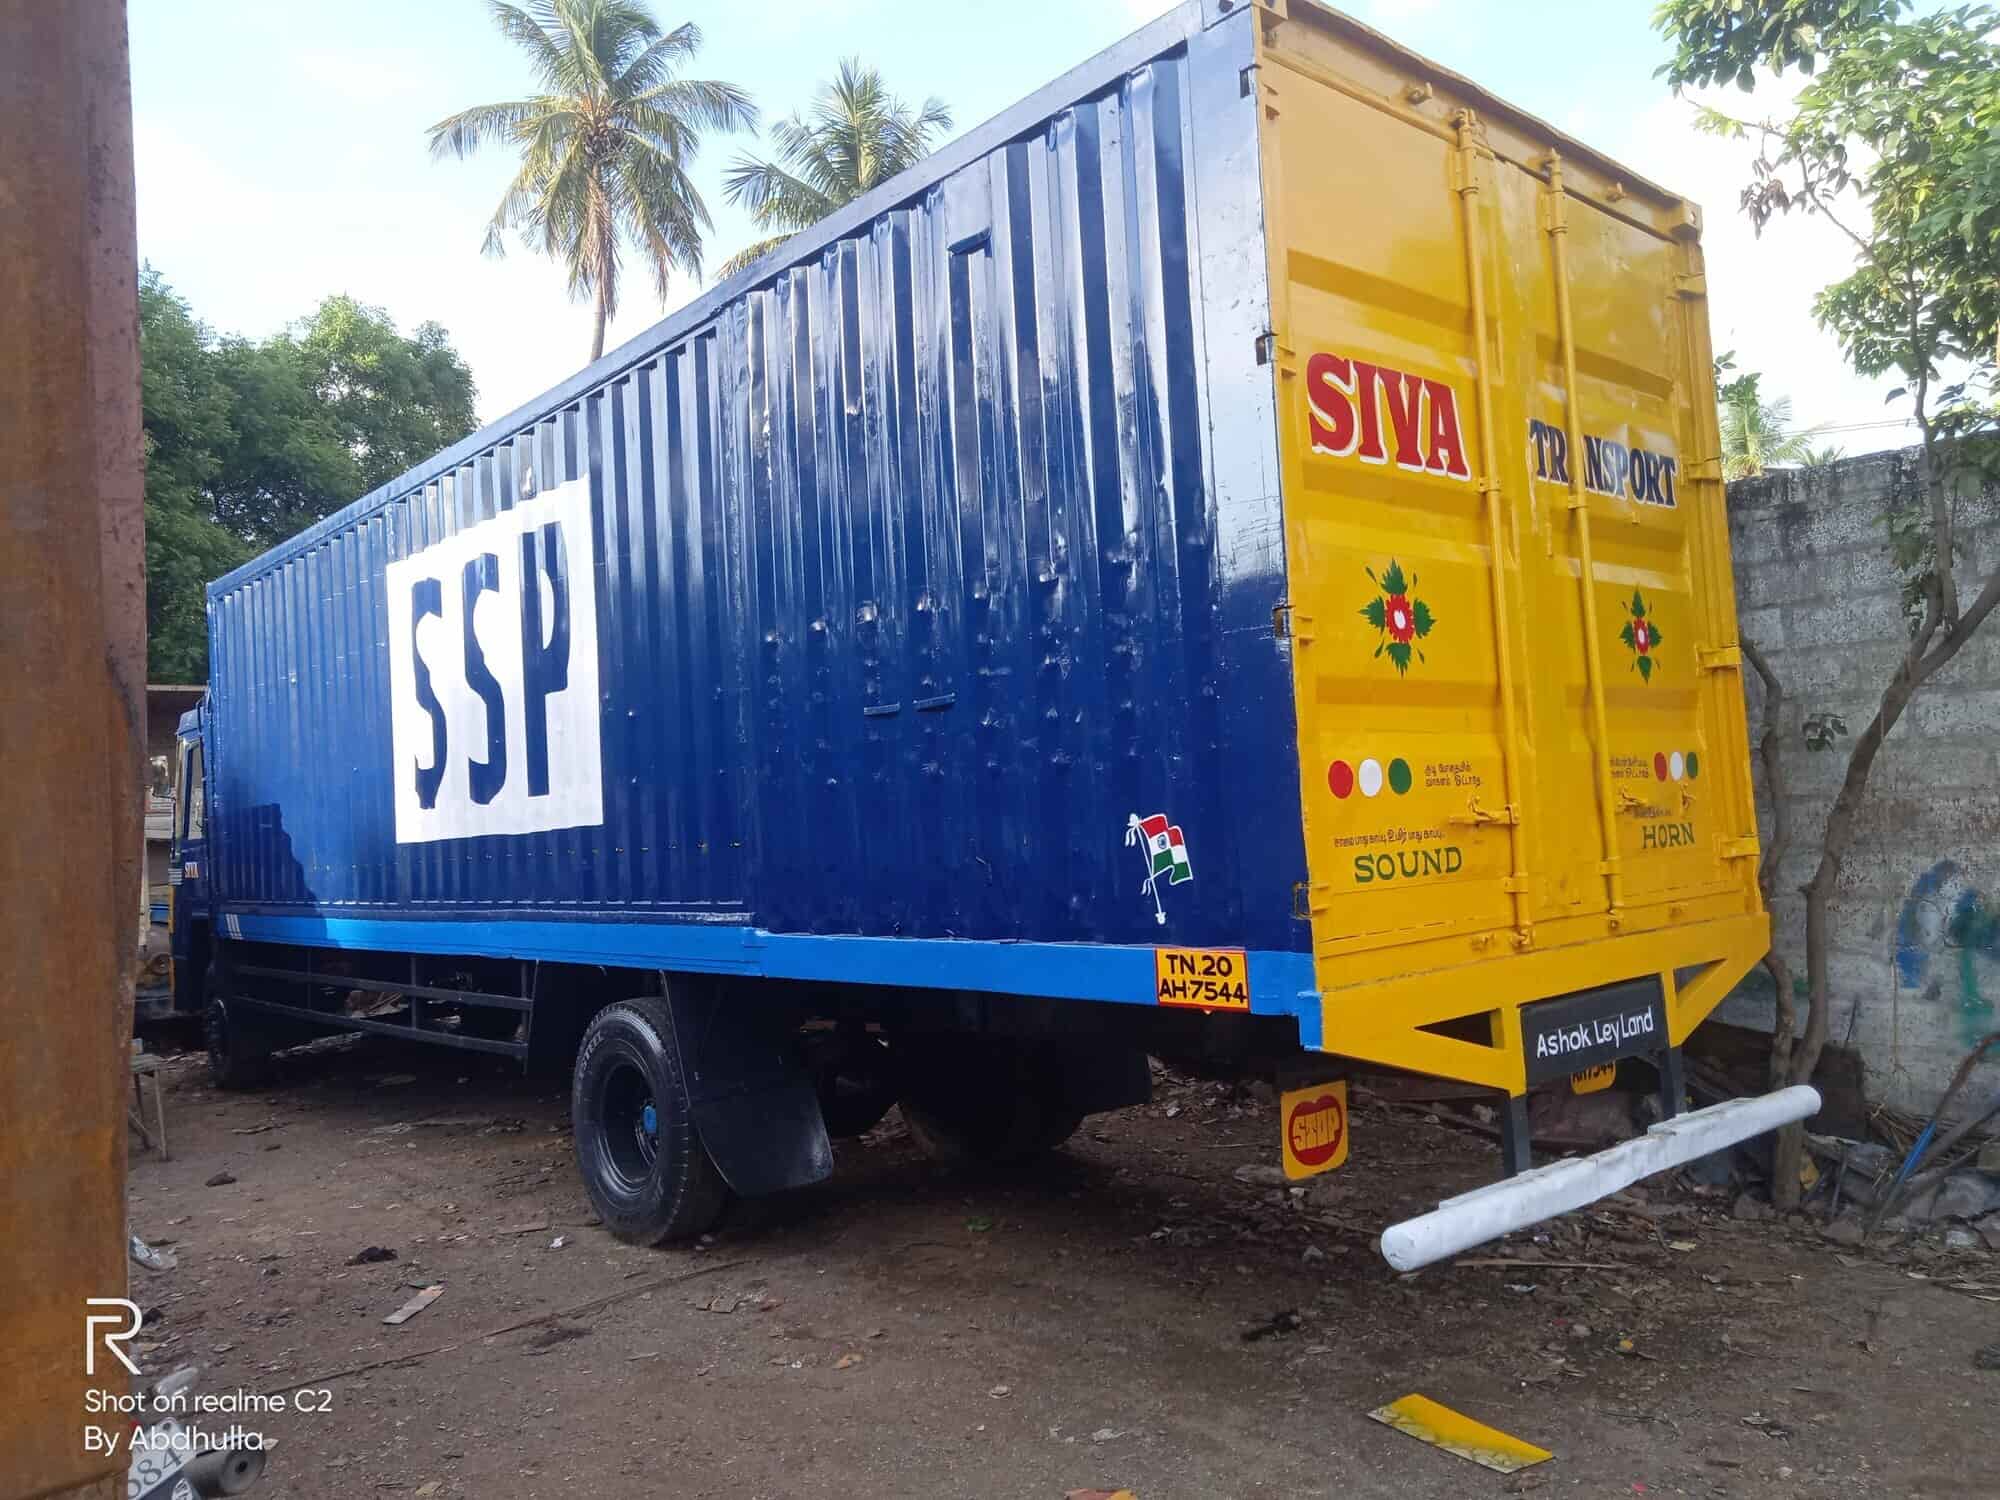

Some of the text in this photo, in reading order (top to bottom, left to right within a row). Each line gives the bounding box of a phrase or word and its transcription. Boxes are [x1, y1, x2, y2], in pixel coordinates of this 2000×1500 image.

[1307, 353, 1472, 482] SIVA
[1527, 418, 1678, 508] TRNSPORT
[411, 521, 571, 809] SSP
[1642, 822, 1696, 849] HORN
[1354, 847, 1463, 883] SOUND
[1536, 1023, 1592, 1059] Ashok
[1293, 1107, 1341, 1152] STOP
